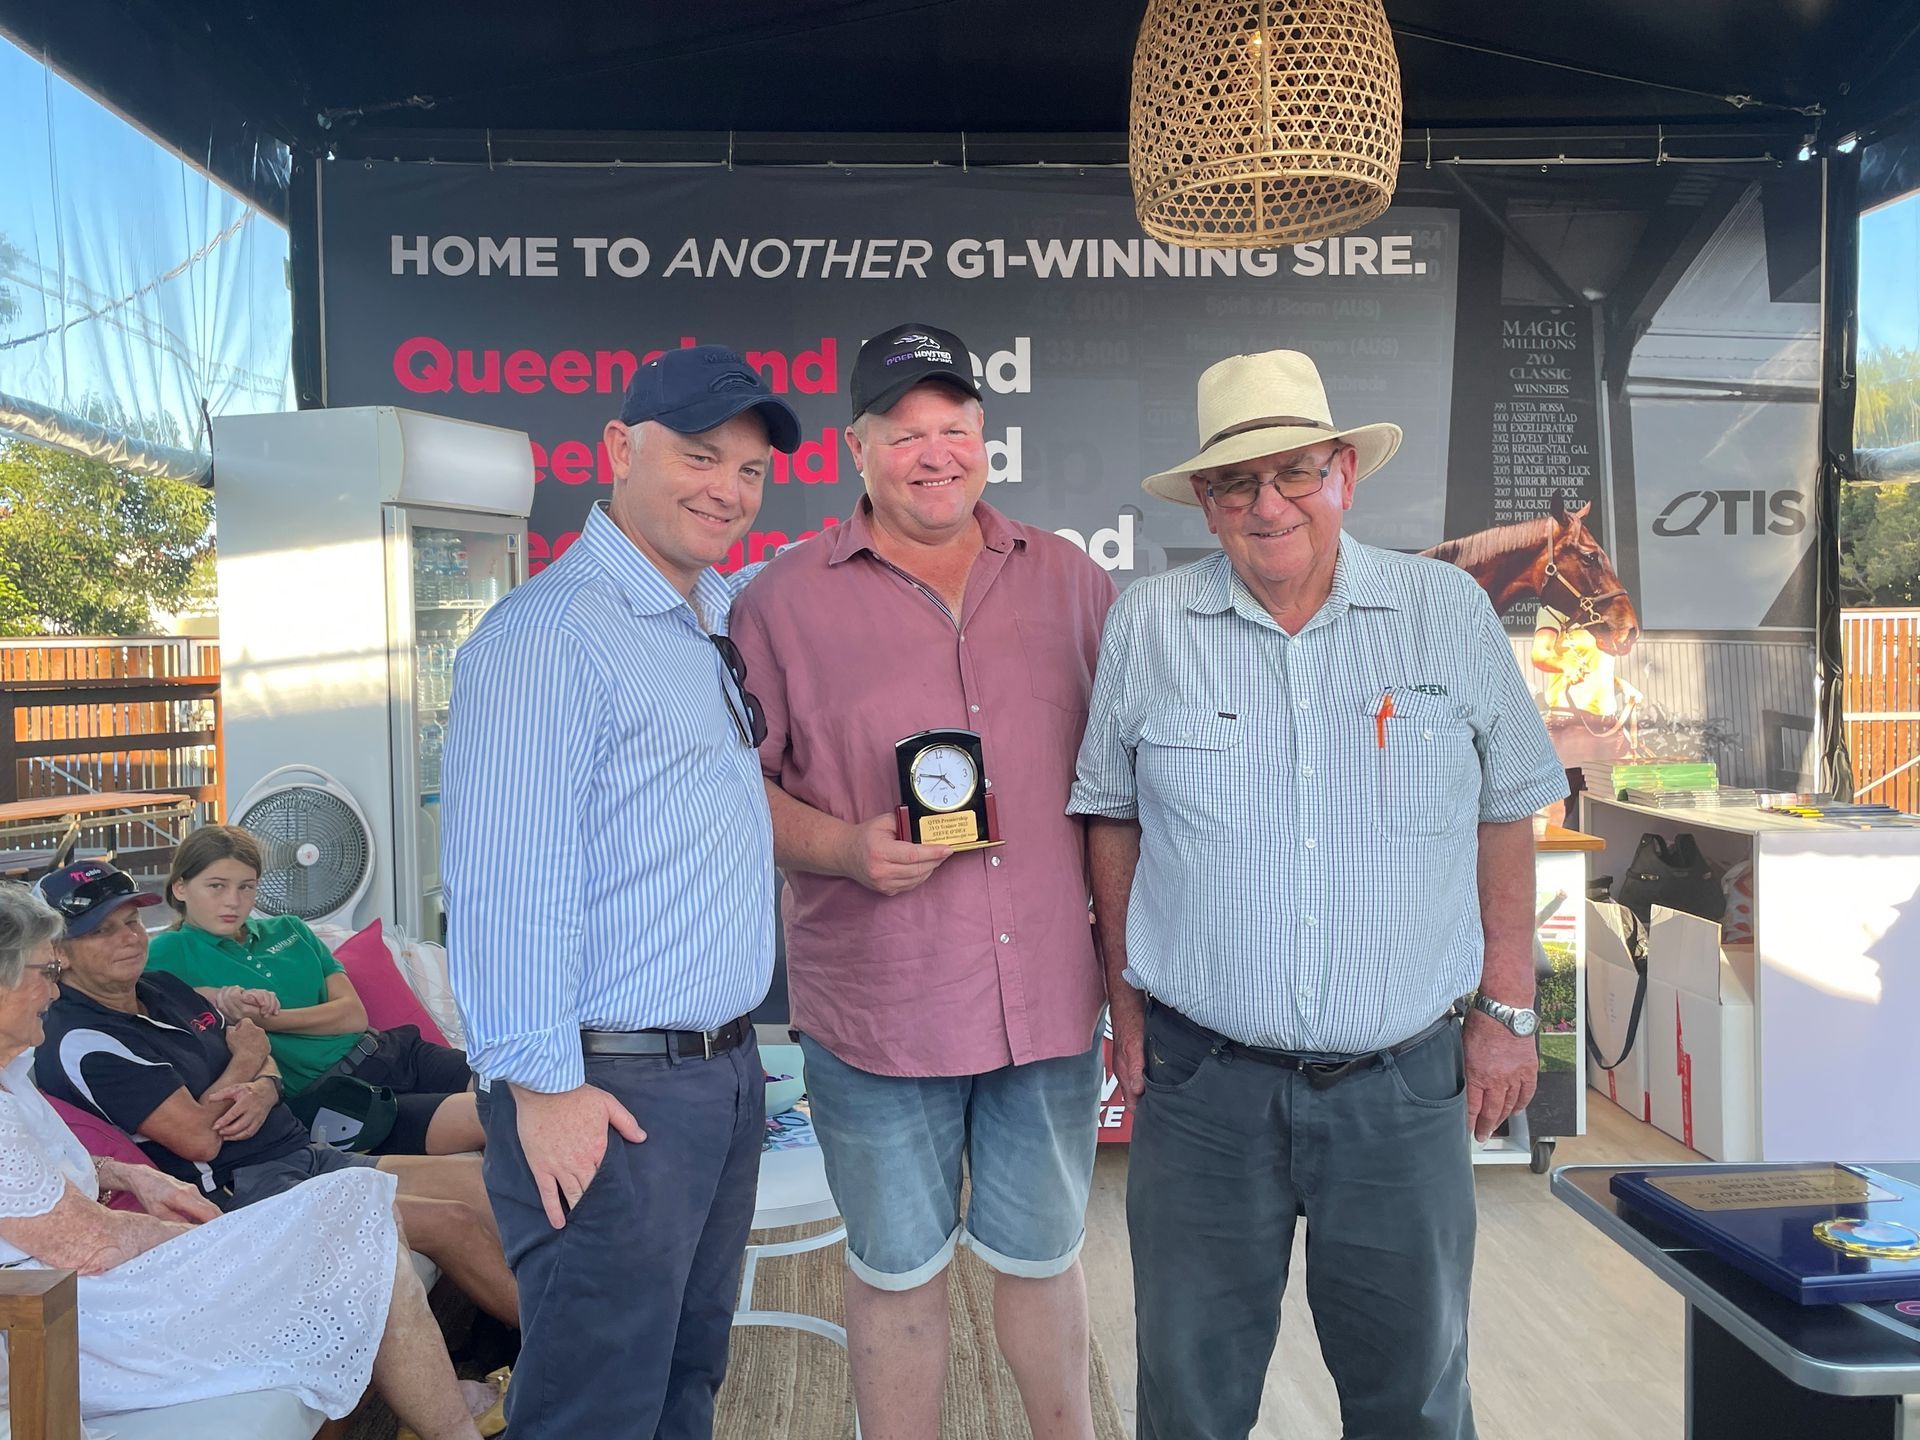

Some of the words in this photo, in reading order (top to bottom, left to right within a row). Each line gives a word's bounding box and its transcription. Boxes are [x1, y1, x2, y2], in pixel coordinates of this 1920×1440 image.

[391, 235, 558, 277] HOME
[573, 237, 650, 278] TO
[661, 238, 933, 279] ANOTHER
[946, 238, 1278, 279] G1-WINNING
[1292, 235, 1427, 277] SIRE.
[1502, 320, 1577, 338] MAGIC
[1502, 338, 1577, 350] MILLIONS
[1525, 353, 1555, 365] 2YO
[1509, 367, 1572, 380] CLASSIC
[1513, 383, 1570, 394] WINNERS
[1509, 402, 1537, 412] TESTA
[1511, 413, 1556, 422] ASSERTIVE
[1559, 413, 1578, 423] LAD
[1511, 433, 1544, 443] LOVELY
[1548, 434, 1573, 445] JUBLY
[1512, 444, 1568, 454] REGIMENTAL
[1570, 445, 1589, 454] GAL
[1513, 455, 1544, 464] DANCE
[1546, 455, 1571, 465] HERO
[1568, 466, 1591, 476] LUCK
[1514, 476, 1548, 486] MIRROR
[1550, 477, 1585, 486] MIRROR
[1514, 487, 1537, 497] MIMI
[1514, 499, 1551, 510] AUGUST
[1563, 500, 1587, 509] ROUD
[1651, 489, 1807, 537] QTIS
[1515, 602, 1541, 612] CAPIT
[962, 768, 968, 778] 3
[942, 794, 949, 805] 6
